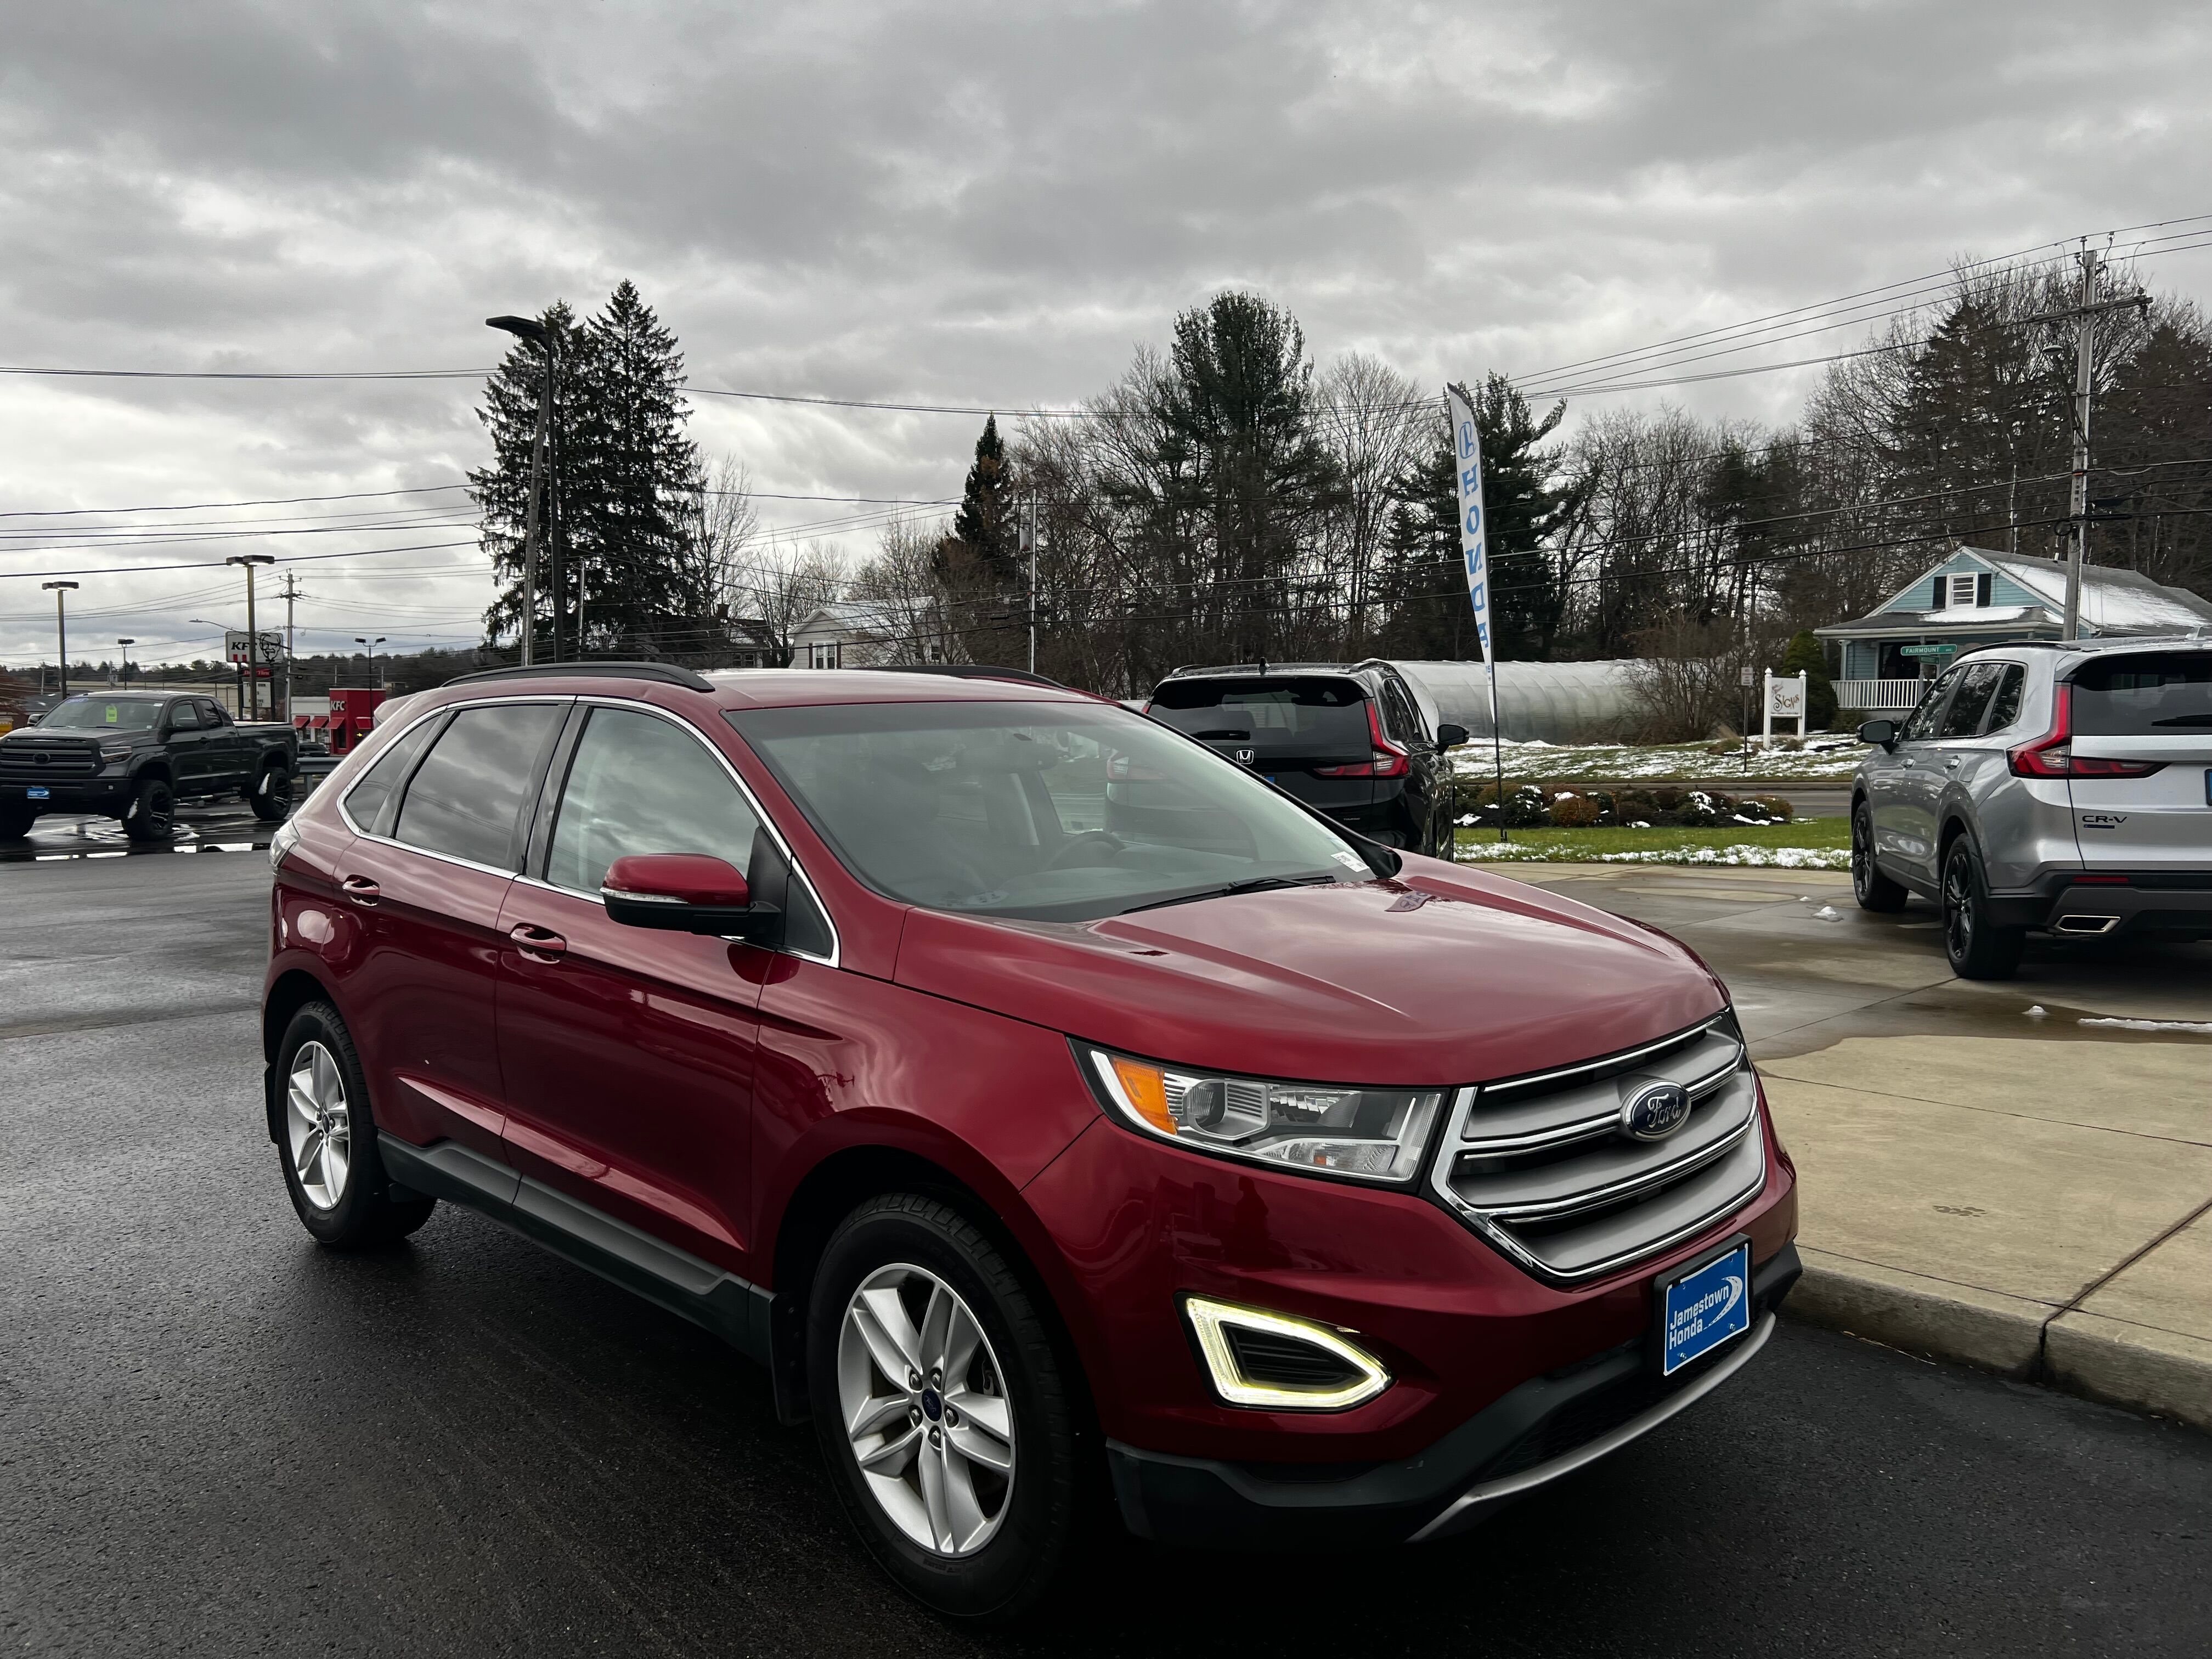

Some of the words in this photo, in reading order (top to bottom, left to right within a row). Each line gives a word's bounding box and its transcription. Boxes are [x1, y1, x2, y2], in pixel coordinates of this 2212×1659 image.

[231, 642, 257, 651] KF
[330, 701, 345, 711] KFC
[1647, 1093, 1681, 1128] Ford
[1670, 1285, 1729, 1330] Jamestown
[1669, 1316, 1703, 1350] Honda
